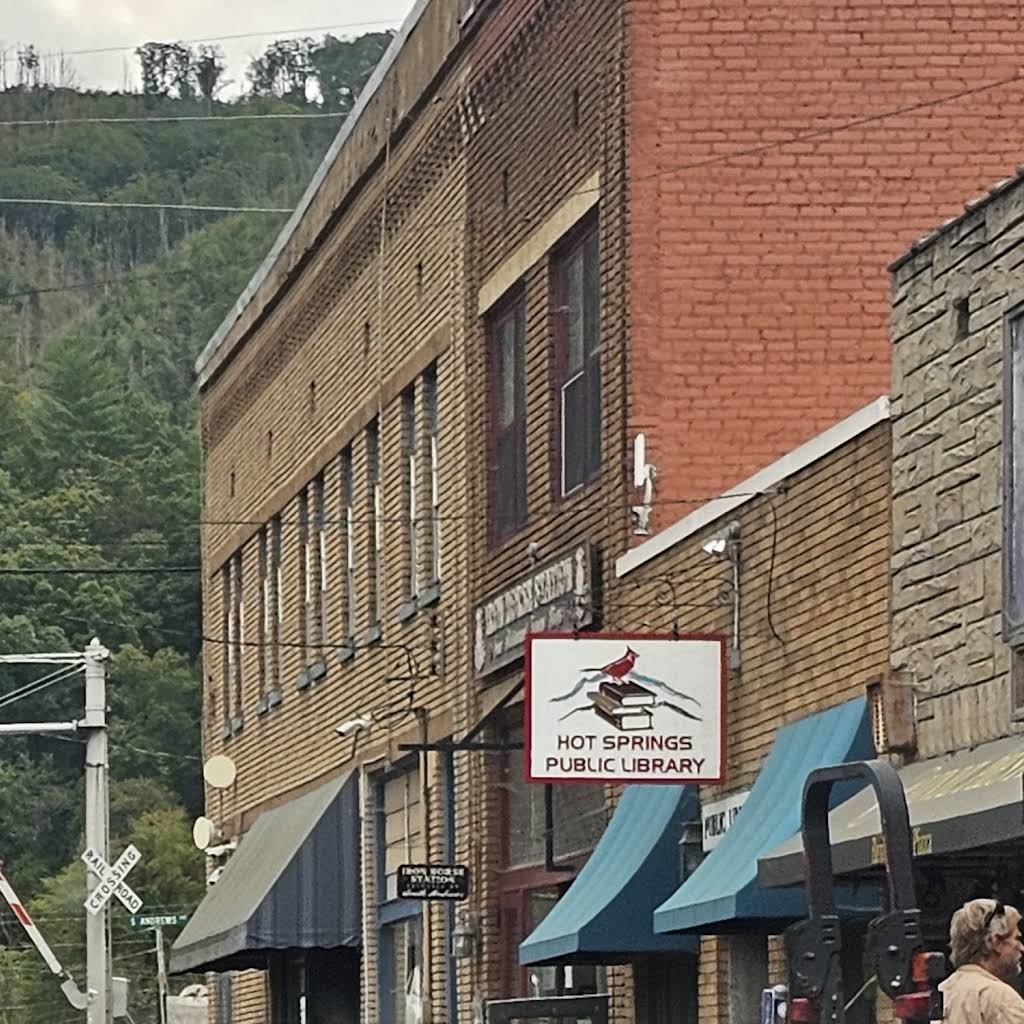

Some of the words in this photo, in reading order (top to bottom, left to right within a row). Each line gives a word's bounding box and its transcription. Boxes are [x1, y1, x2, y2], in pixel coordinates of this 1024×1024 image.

[558, 735, 596, 750] HOT
[603, 735, 692, 750] SPRINGS
[546, 757, 615, 772] PUBLIC
[621, 758, 705, 774] LIBRARY
[86, 850, 105, 876] RAIL
[115, 883, 140, 910] ROAD
[90, 851, 137, 909] CROSSING
[402, 868, 427, 876] IRON
[430, 868, 464, 877] HORSE
[410, 875, 456, 884] STATION
